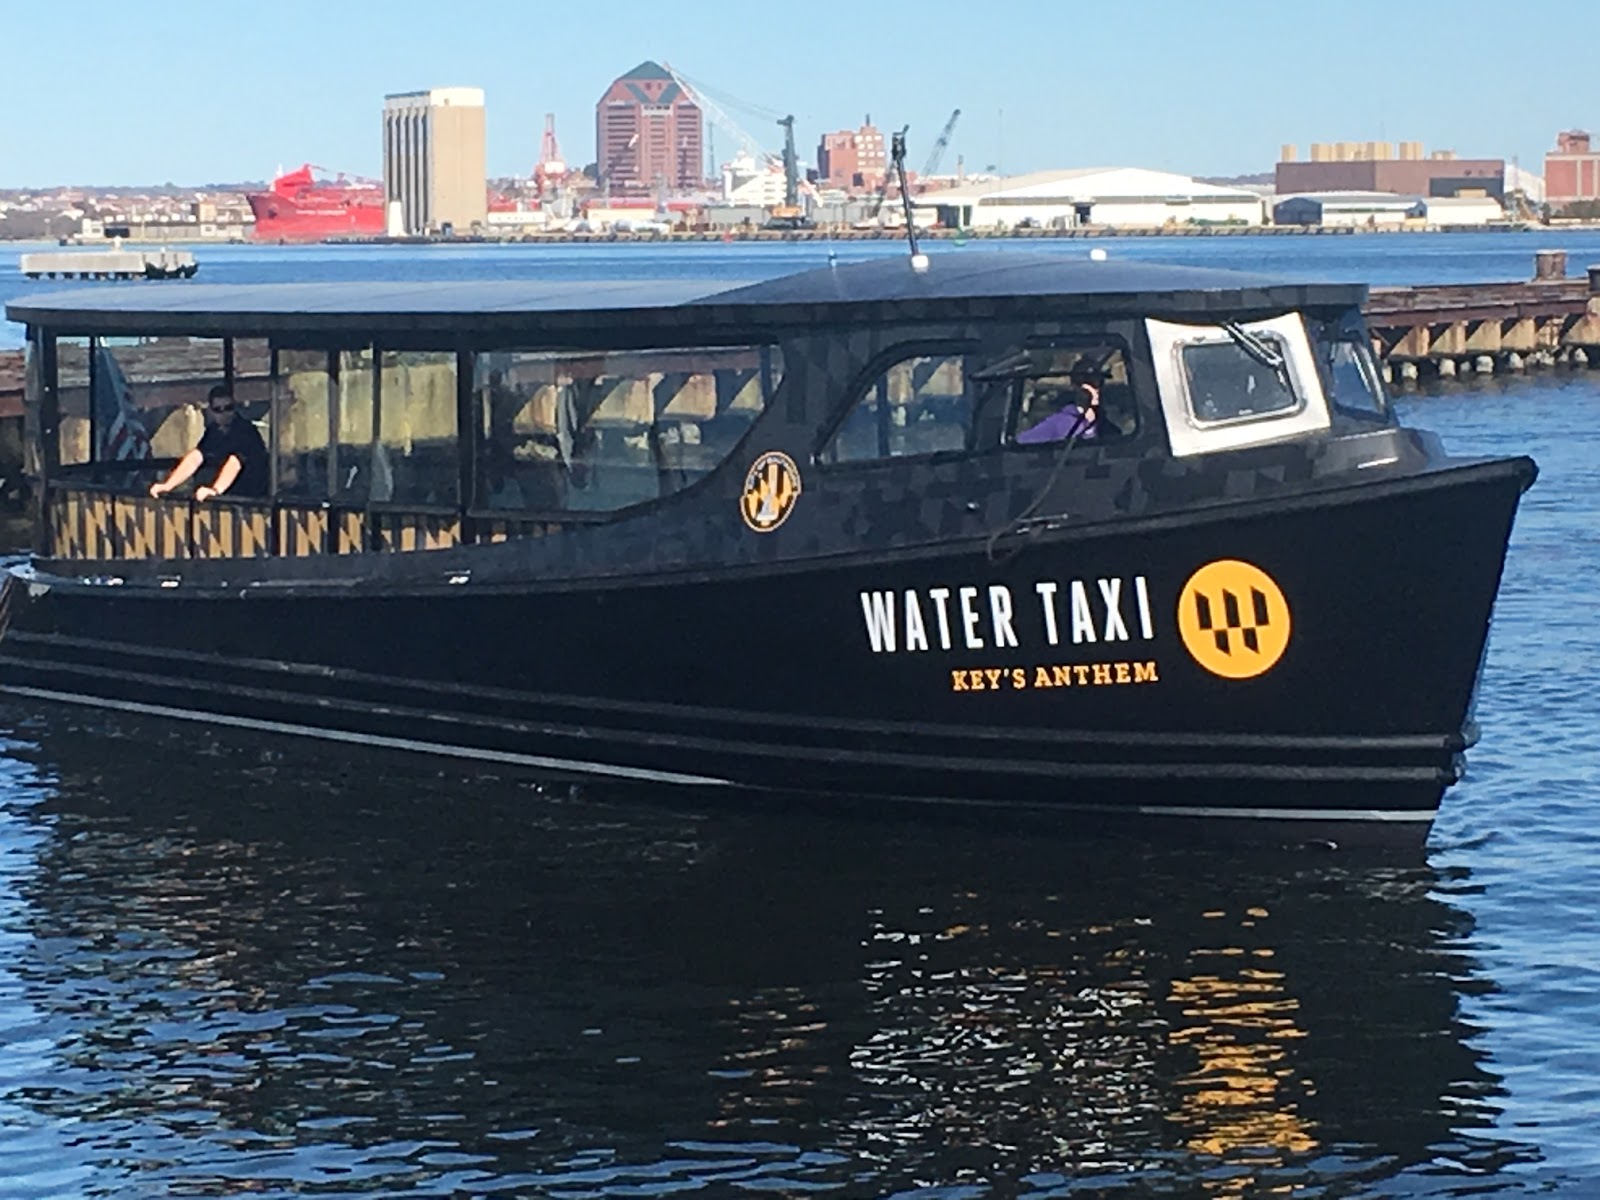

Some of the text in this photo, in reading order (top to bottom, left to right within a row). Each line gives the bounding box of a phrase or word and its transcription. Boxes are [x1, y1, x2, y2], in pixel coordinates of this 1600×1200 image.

[860, 576, 1154, 653] WATER TAXI
[951, 661, 1159, 691] KEY'S ANTHEM
